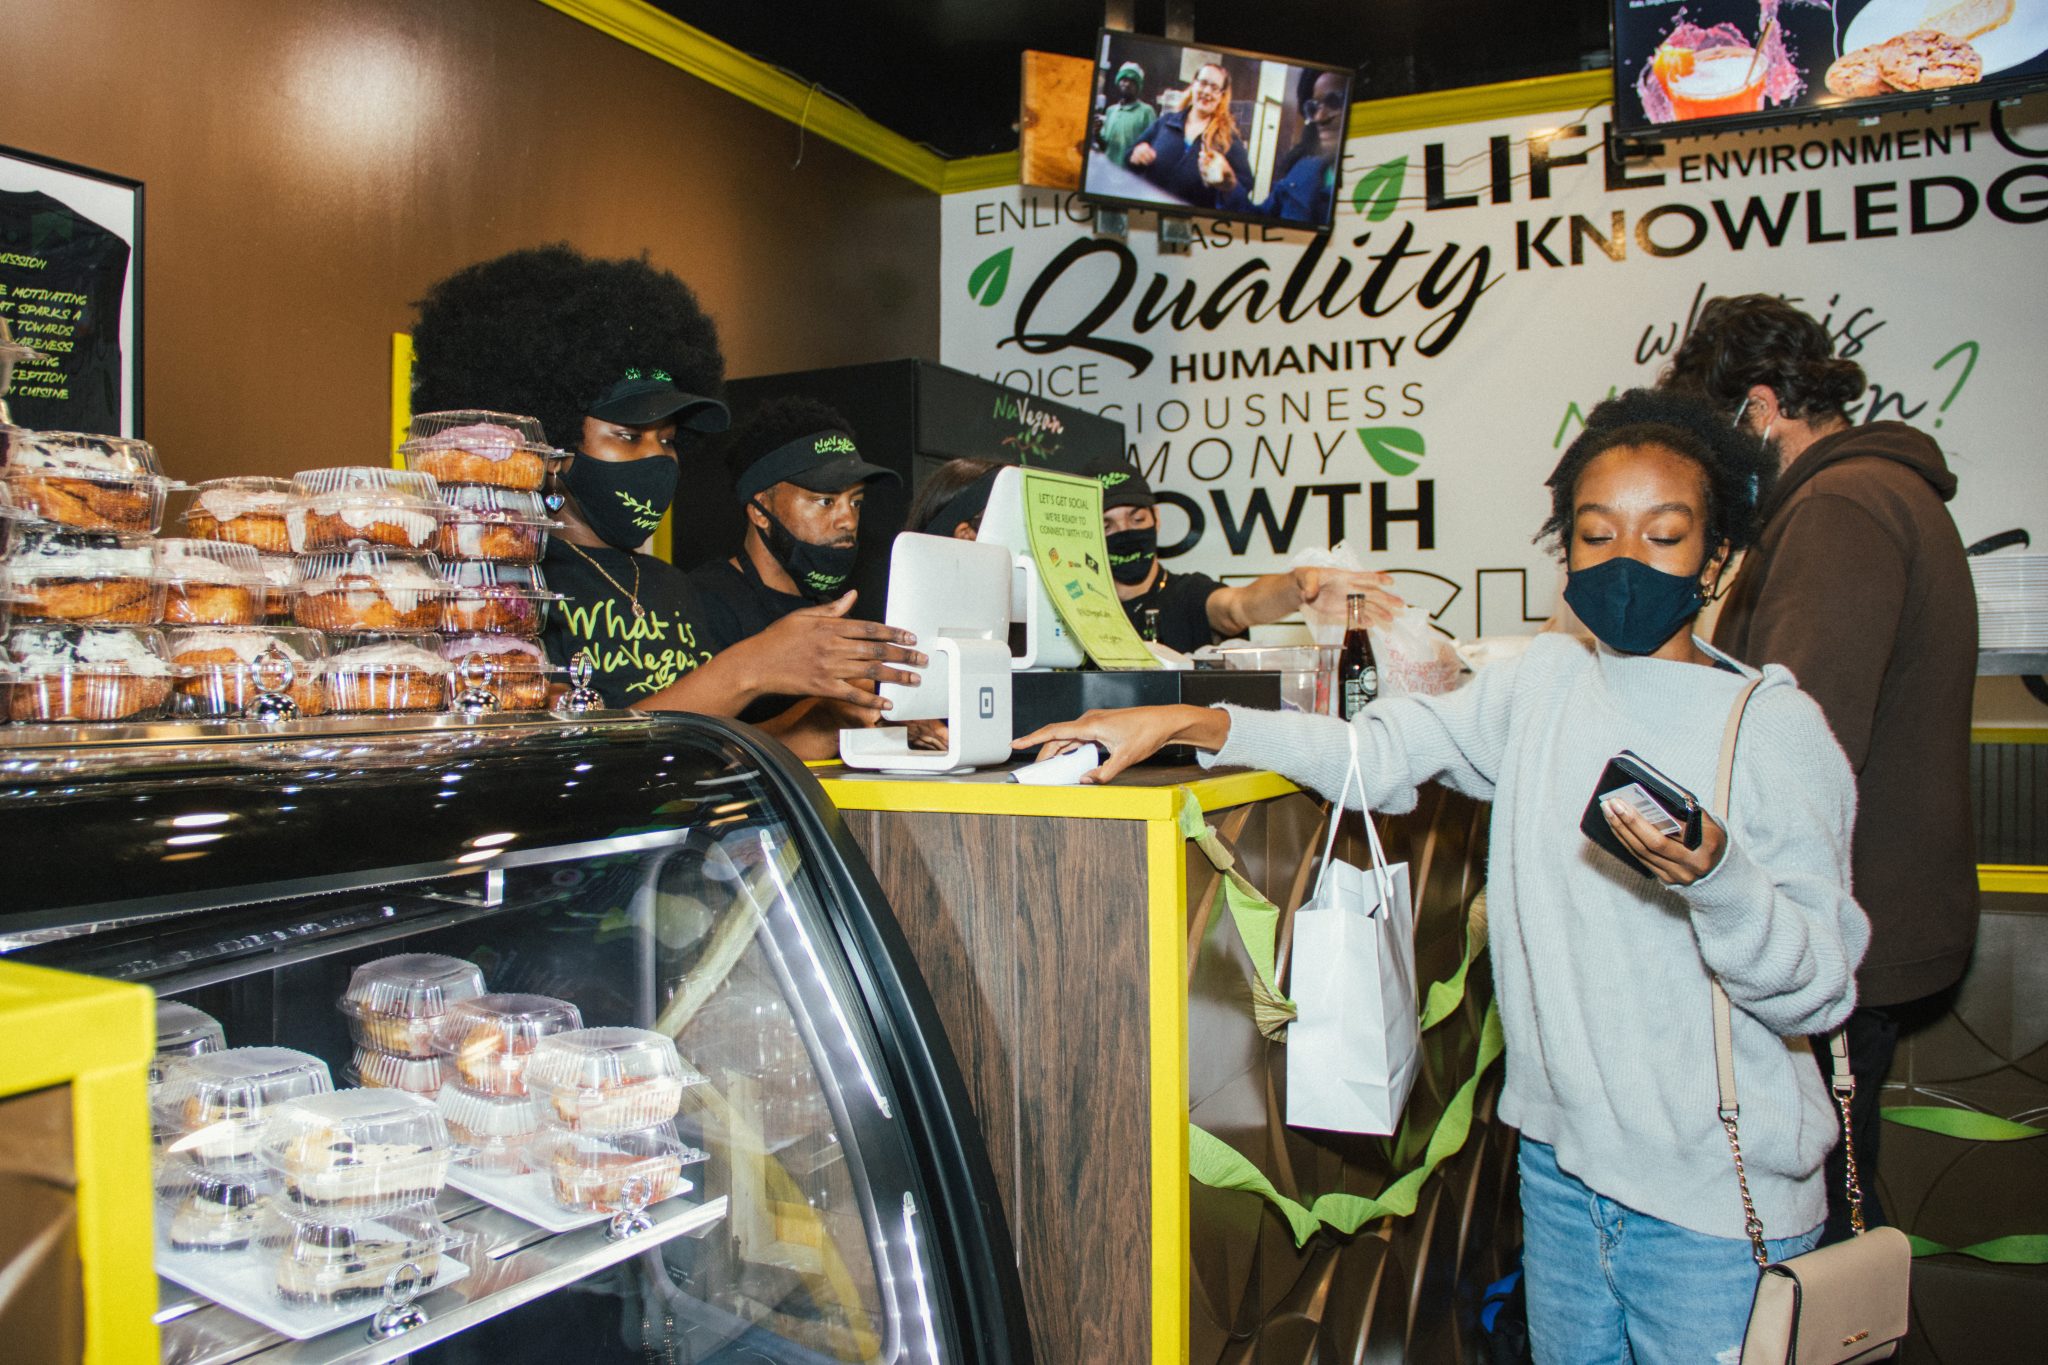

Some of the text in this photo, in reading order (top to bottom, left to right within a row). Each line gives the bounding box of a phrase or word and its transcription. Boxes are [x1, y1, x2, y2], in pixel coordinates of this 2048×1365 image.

[1424, 122, 1666, 212] LIFE
[1680, 122, 1980, 183] ENVIRONMENT
[1171, 219, 1284, 253] ASTE
[12, 287, 87, 305] MOTIVATING
[18, 303, 71, 320] SPARKS
[73, 309, 82, 321] A
[996, 220, 1506, 379] Quality
[17, 320, 75, 337] TOWARDS
[1170, 335, 1407, 385] HUMANITY
[19, 386, 69, 400] CUISINE
[1055, 495, 1068, 507] GET
[559, 599, 696, 648] What is
